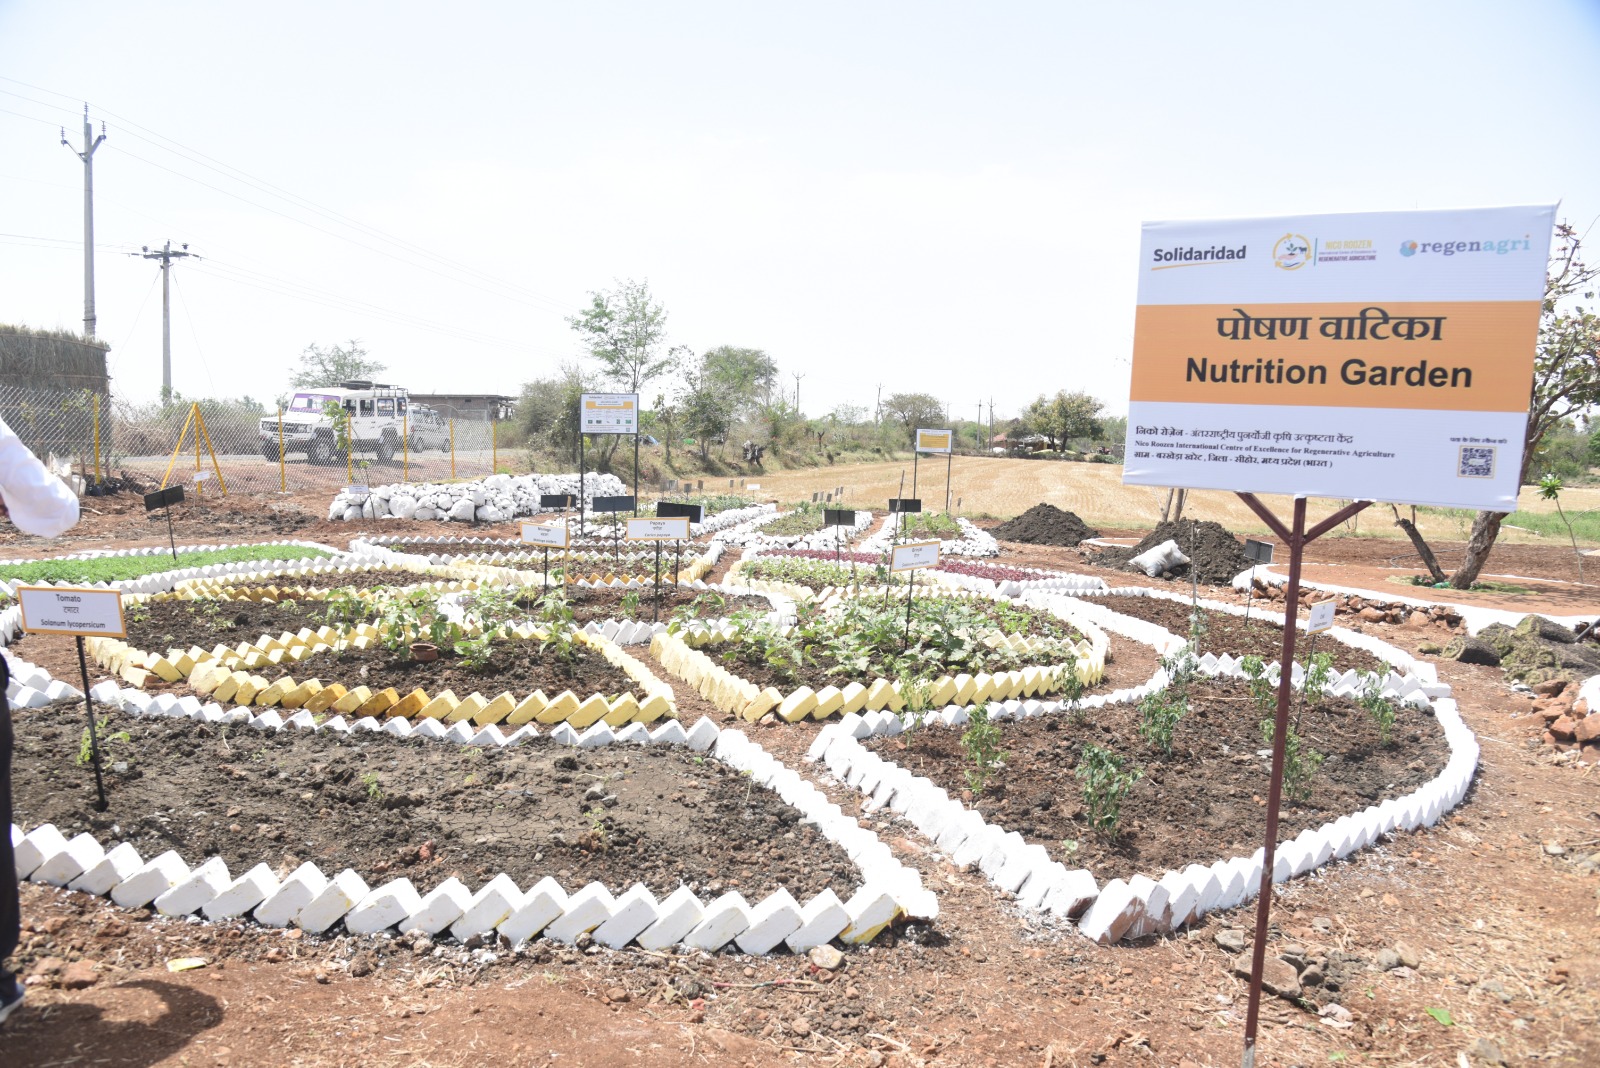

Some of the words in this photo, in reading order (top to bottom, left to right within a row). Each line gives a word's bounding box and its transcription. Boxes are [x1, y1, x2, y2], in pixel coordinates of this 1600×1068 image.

[1153, 245, 1247, 262] Solidaridad
[1420, 234, 1532, 257] regenagri
[1216, 308, 1312, 340] पोषण
[1319, 306, 1447, 341] वाटिका
[1186, 357, 1327, 384] Nutrition
[1340, 358, 1473, 388] Garden
[1135, 425, 1158, 435] निको
[1176, 442, 1219, 450] International
[1220, 443, 1243, 451] Centre
[1303, 447, 1350, 455] Regenerative
[1352, 450, 1395, 458] Agriculture
[55, 594, 81, 602] Tomato
[41, 619, 66, 627] Solanum
[67, 619, 106, 629] lycopersicum
